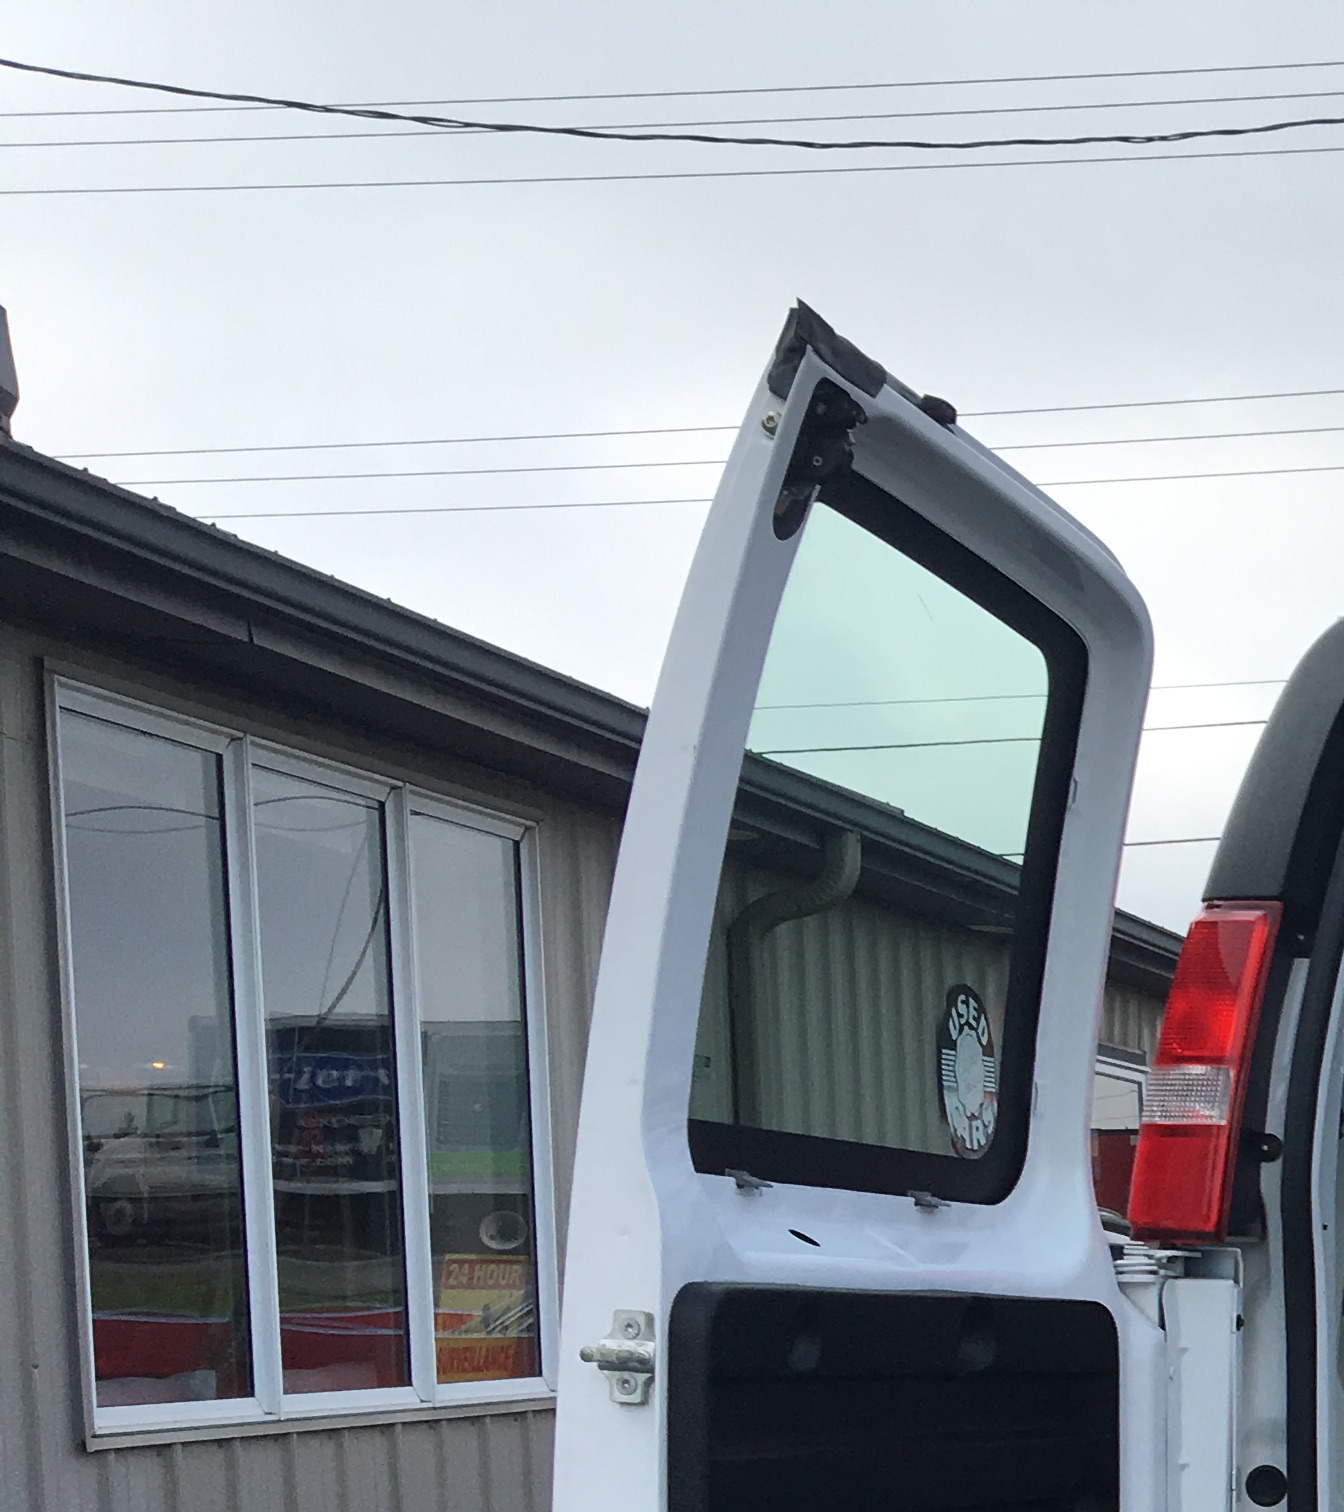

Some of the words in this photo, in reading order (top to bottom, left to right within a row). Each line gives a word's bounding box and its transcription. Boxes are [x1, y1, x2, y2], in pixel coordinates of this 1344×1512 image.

[949, 994, 989, 1046] USED
[448, 1263, 469, 1285] 24
[473, 1264, 521, 1285] HOUR
